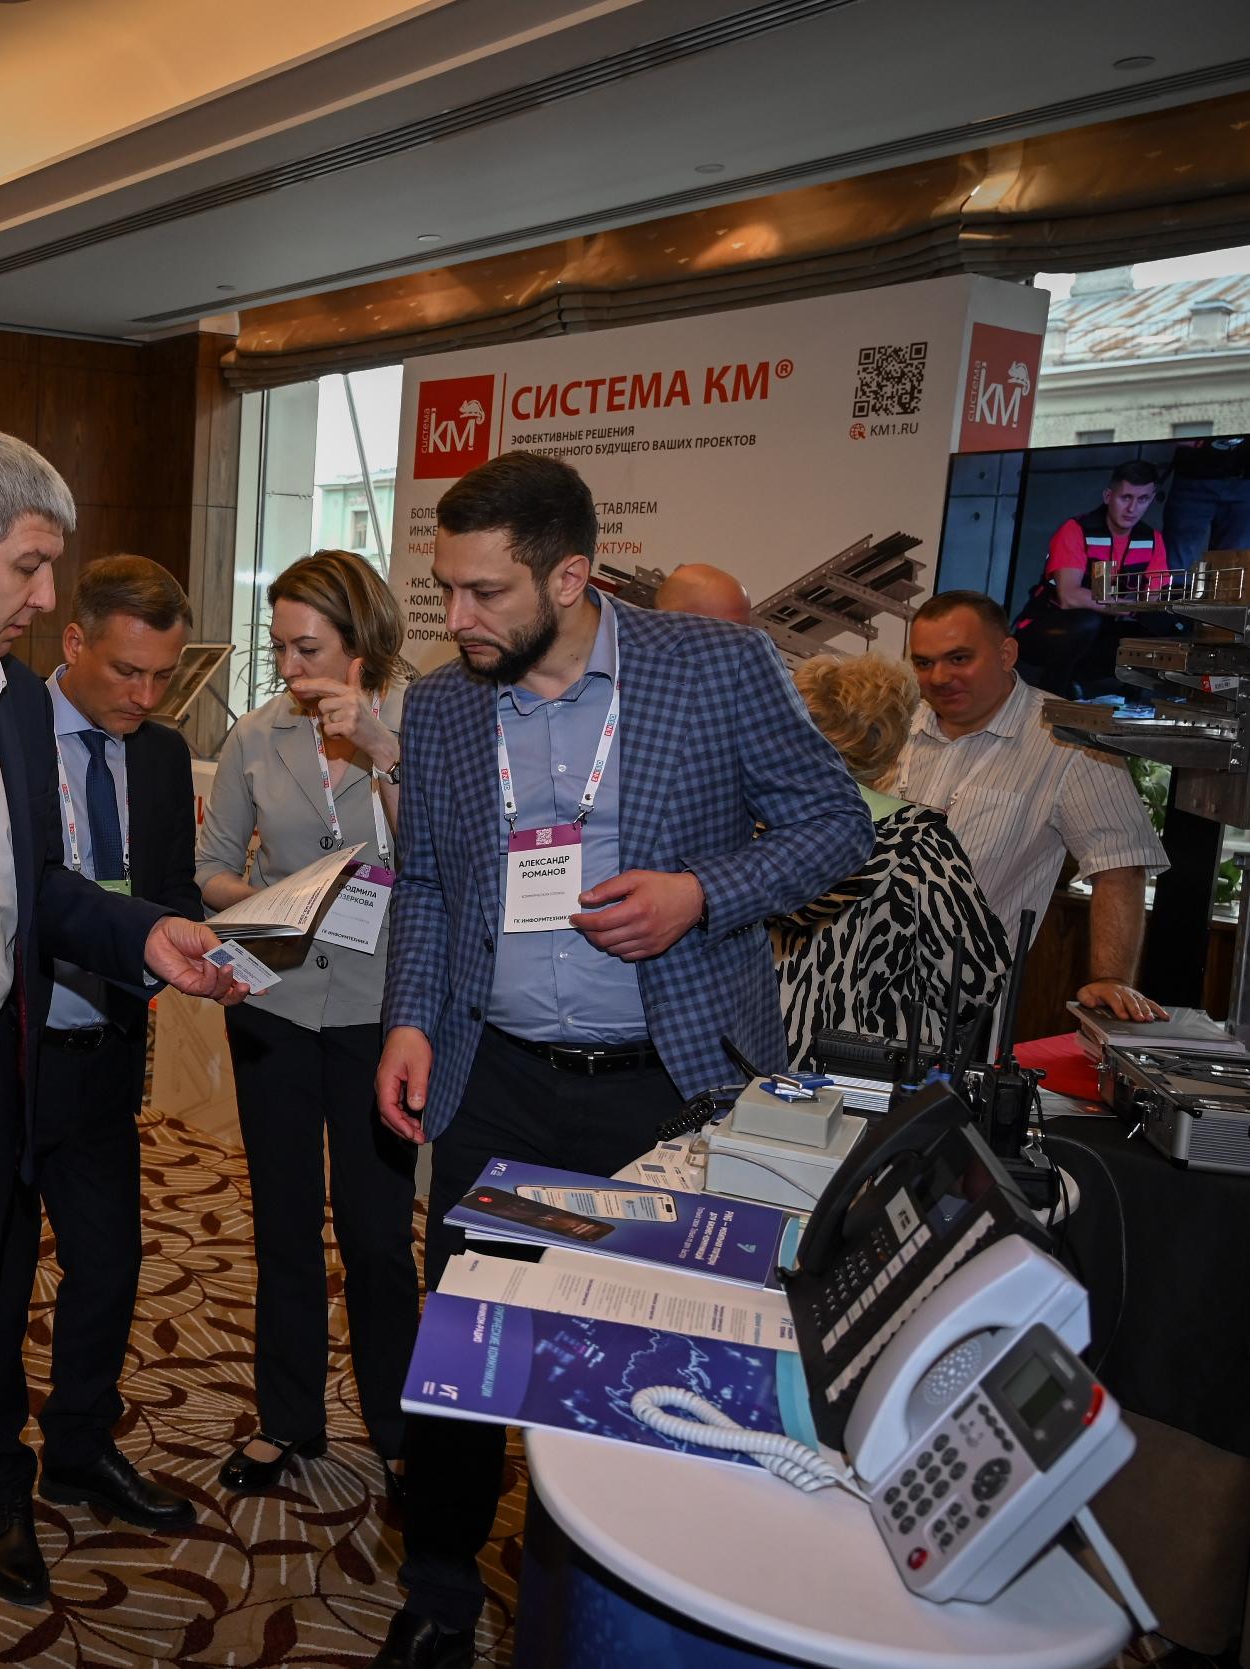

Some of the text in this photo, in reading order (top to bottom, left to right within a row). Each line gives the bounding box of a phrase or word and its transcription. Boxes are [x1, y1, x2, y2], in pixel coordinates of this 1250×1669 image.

[511, 369, 691, 421] СИСТЕМА
[511, 426, 635, 445] ЭФФЕКТИВНЫЕ РЕШЕНИЯ
[870, 423, 919, 437] KM1.RU
[595, 440, 650, 456] БУДУЩЕГО
[652, 438, 692, 451] ВАШИХ
[695, 434, 756, 449] ПРОЕКТОВ
[410, 577, 431, 589] КНС
[518, 855, 570, 868] АЛЕКСАНДР
[521, 867, 566, 879] РОМАНОВ
